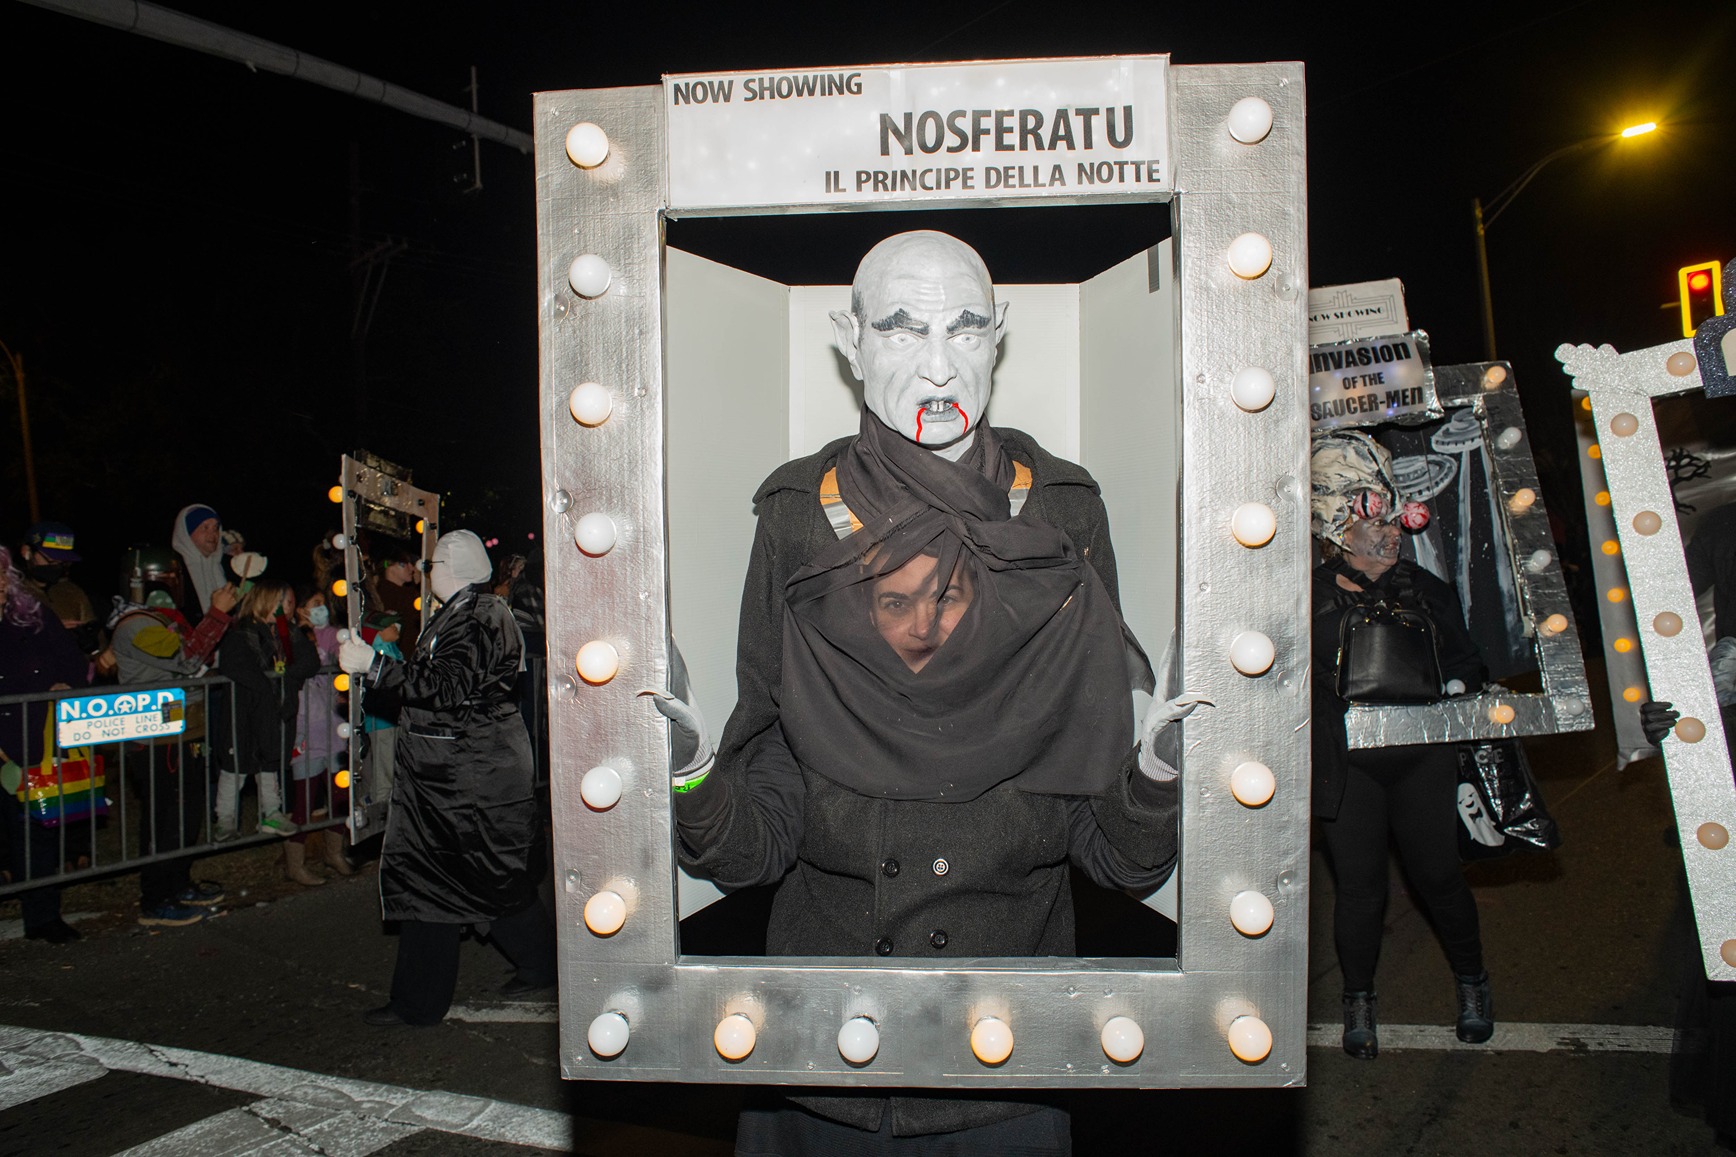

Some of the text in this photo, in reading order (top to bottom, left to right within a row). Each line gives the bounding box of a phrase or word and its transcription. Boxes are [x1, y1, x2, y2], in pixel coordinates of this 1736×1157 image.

[673, 72, 863, 106] NOW SHOWING
[879, 104, 1134, 156] NOSFERATU
[825, 160, 1161, 193] IL PRINCIPE DELLA NOTTE
[1342, 372, 1385, 390] OF THE
[73, 722, 171, 741] DO NOT CROSS
[86, 713, 159, 730] POLICE LINE
